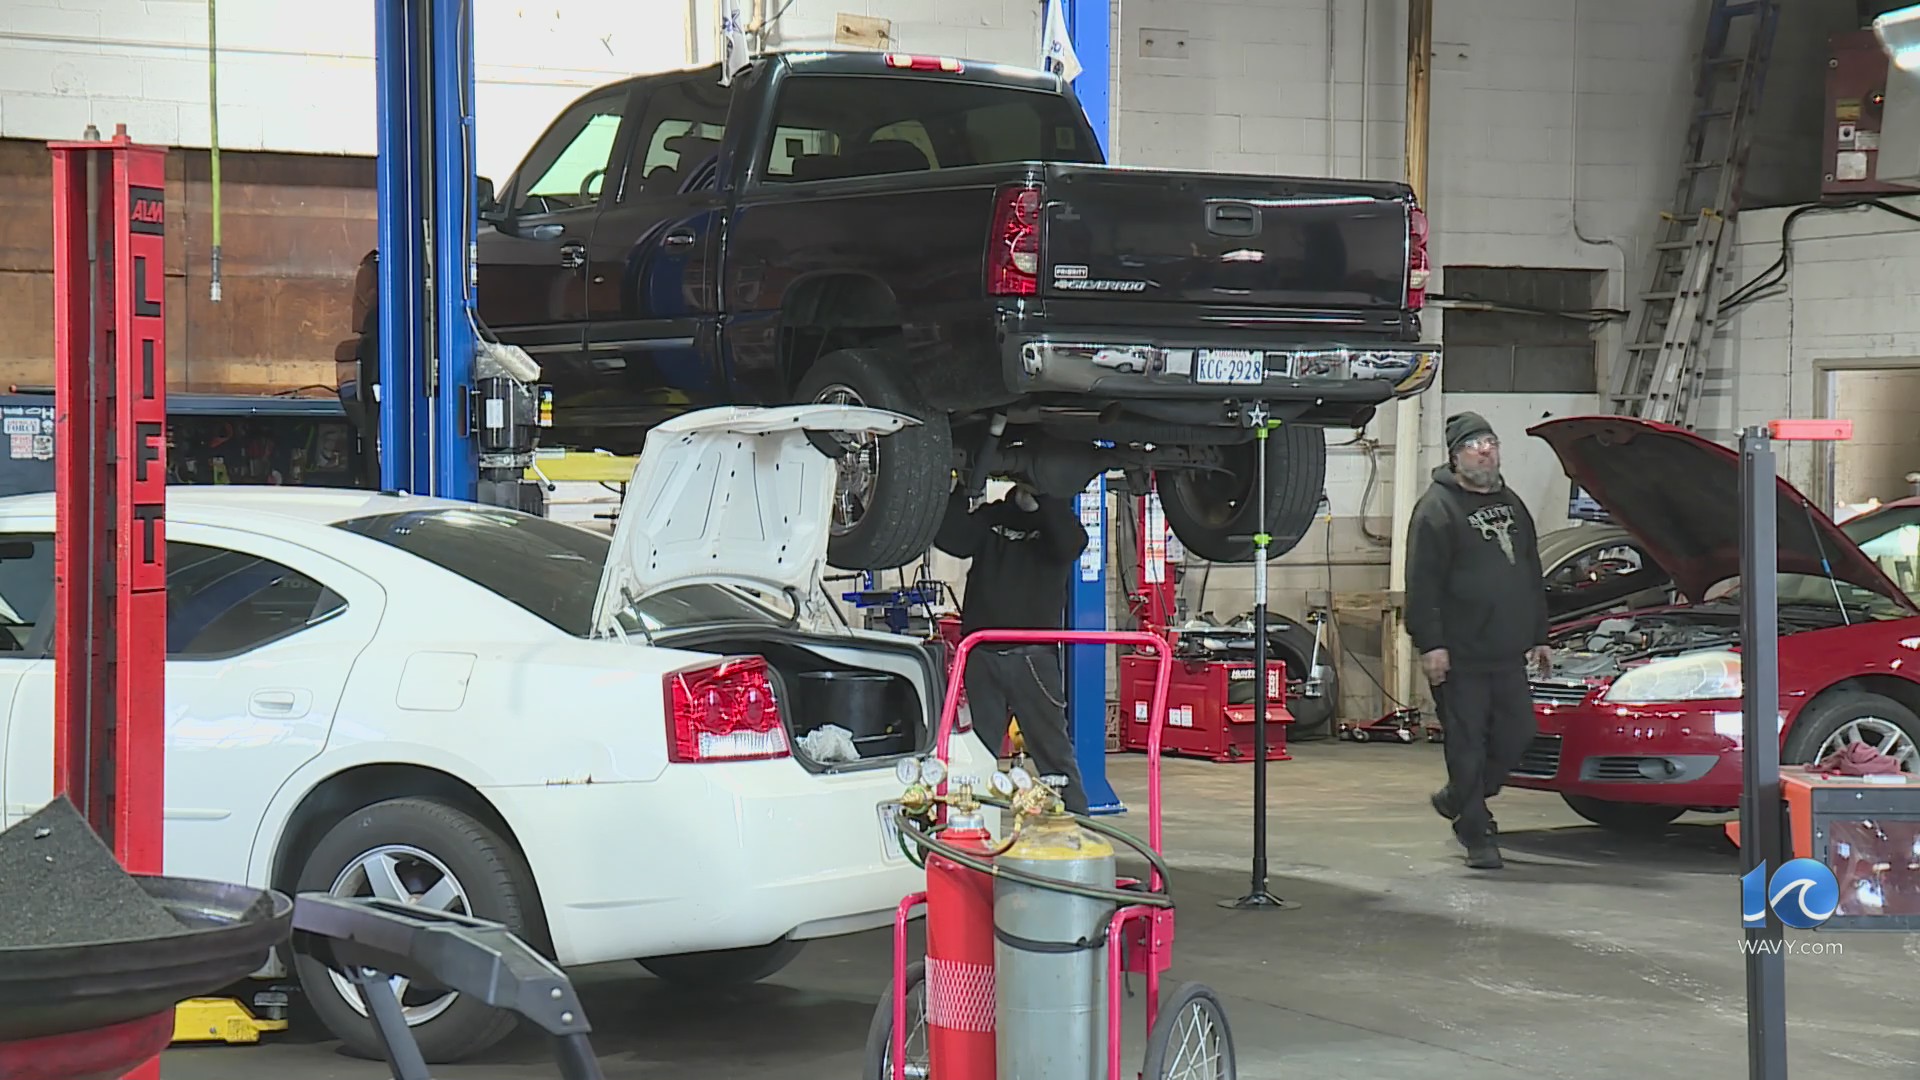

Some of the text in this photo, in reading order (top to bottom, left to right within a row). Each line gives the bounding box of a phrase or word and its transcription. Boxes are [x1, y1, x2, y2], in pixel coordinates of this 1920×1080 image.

[131, 199, 164, 223] ALM
[1068, 280, 1146, 291] SILVERADO
[1214, 350, 1247, 358] VIRGINIA
[1200, 360, 1261, 379] KCG-2928
[133, 256, 163, 564] LIFT
